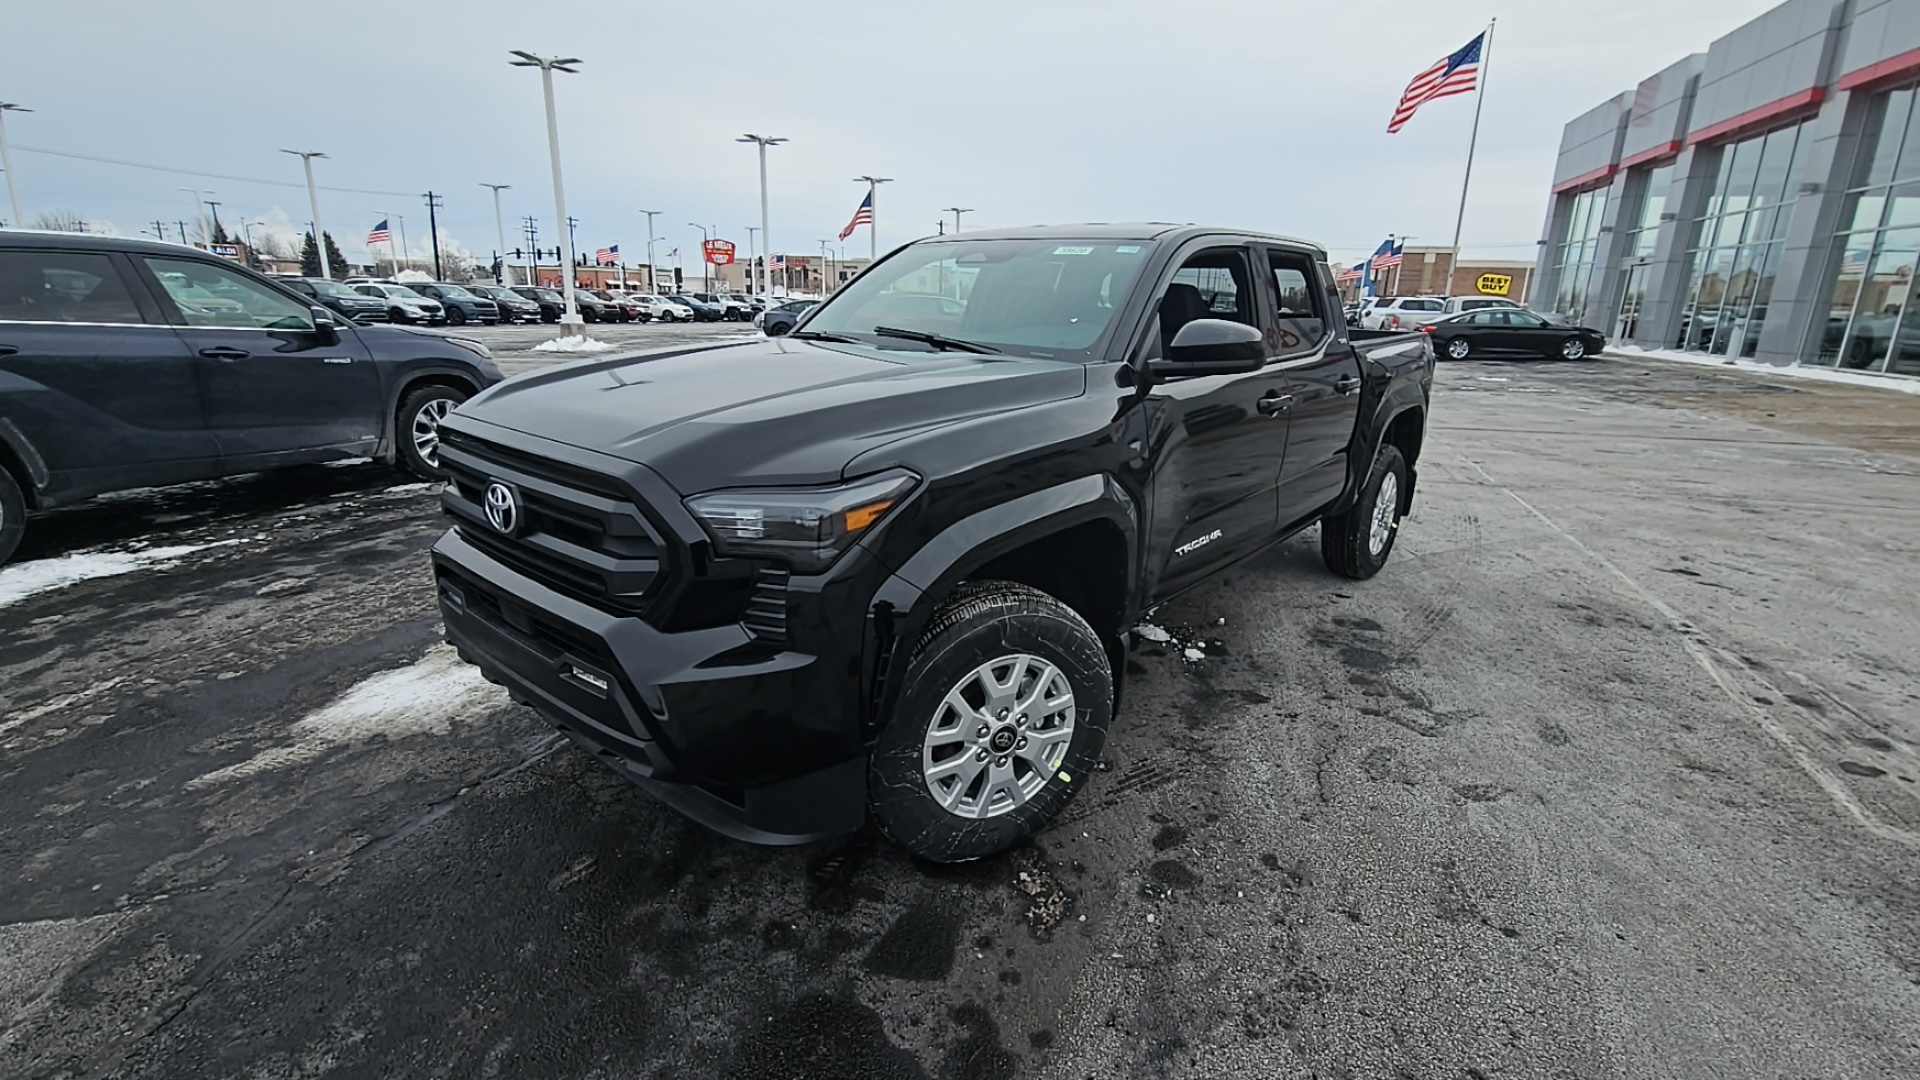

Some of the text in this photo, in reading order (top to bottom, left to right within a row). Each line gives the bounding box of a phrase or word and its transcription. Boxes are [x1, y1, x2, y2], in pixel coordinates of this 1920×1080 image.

[216, 246, 236, 255] ALDI
[1482, 276, 1509, 285] BEST
[1481, 283, 1505, 291] BUY
[1174, 529, 1223, 556] TACOMA
